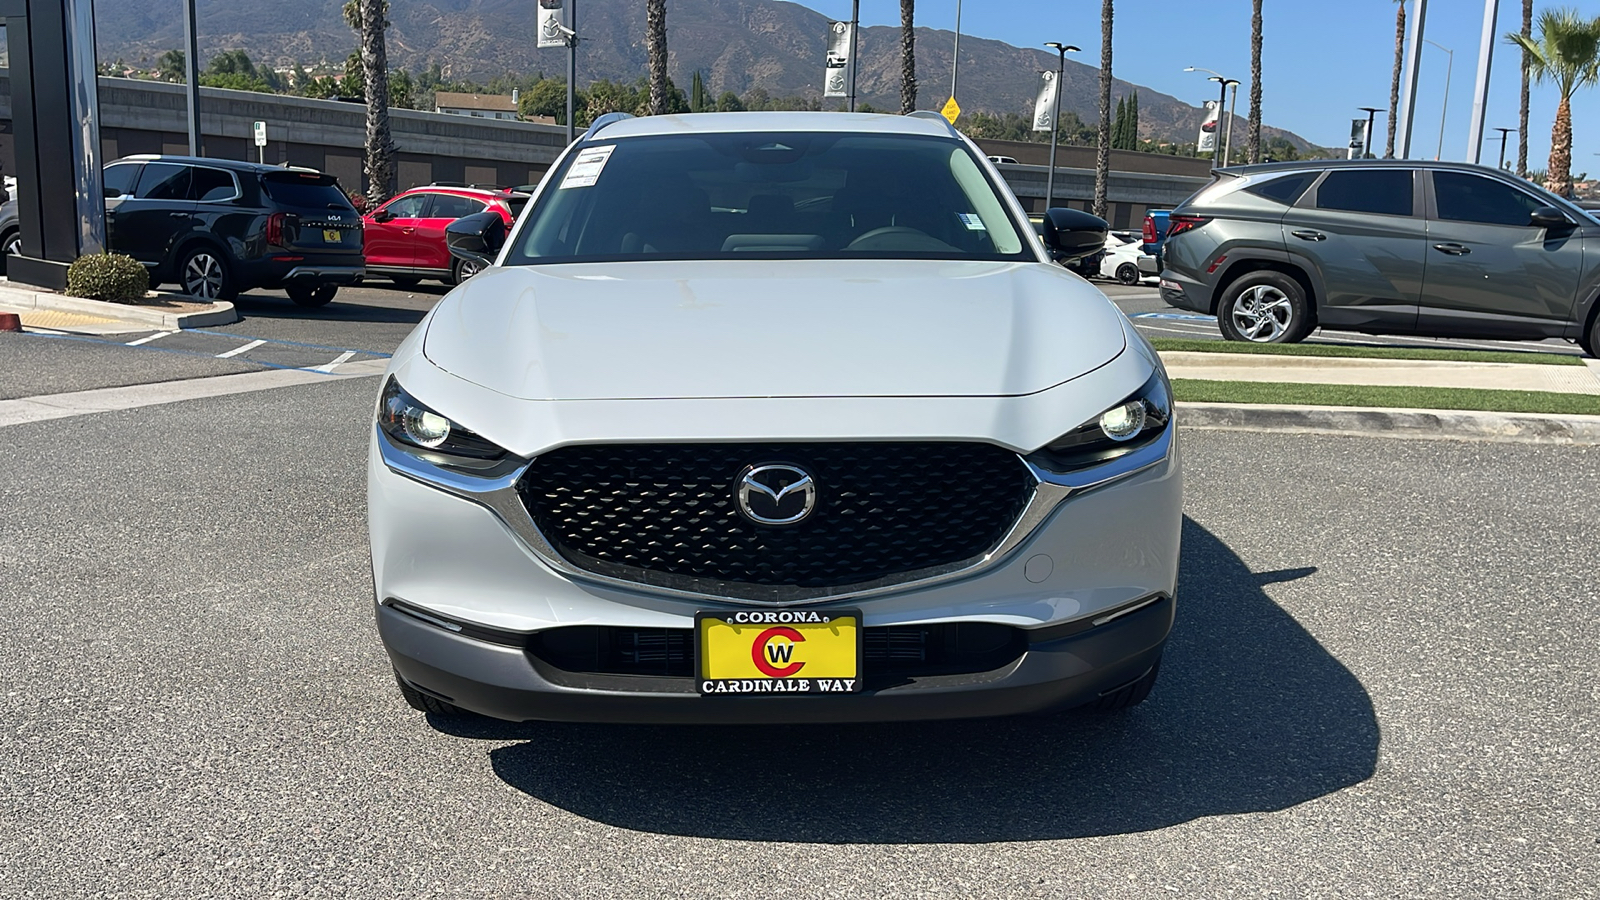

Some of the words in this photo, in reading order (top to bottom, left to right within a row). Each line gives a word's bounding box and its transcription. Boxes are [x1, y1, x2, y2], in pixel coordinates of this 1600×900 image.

[735, 611, 821, 624] CORONA
[702, 680, 811, 693] CARDINALE
[817, 680, 856, 692] WAY
